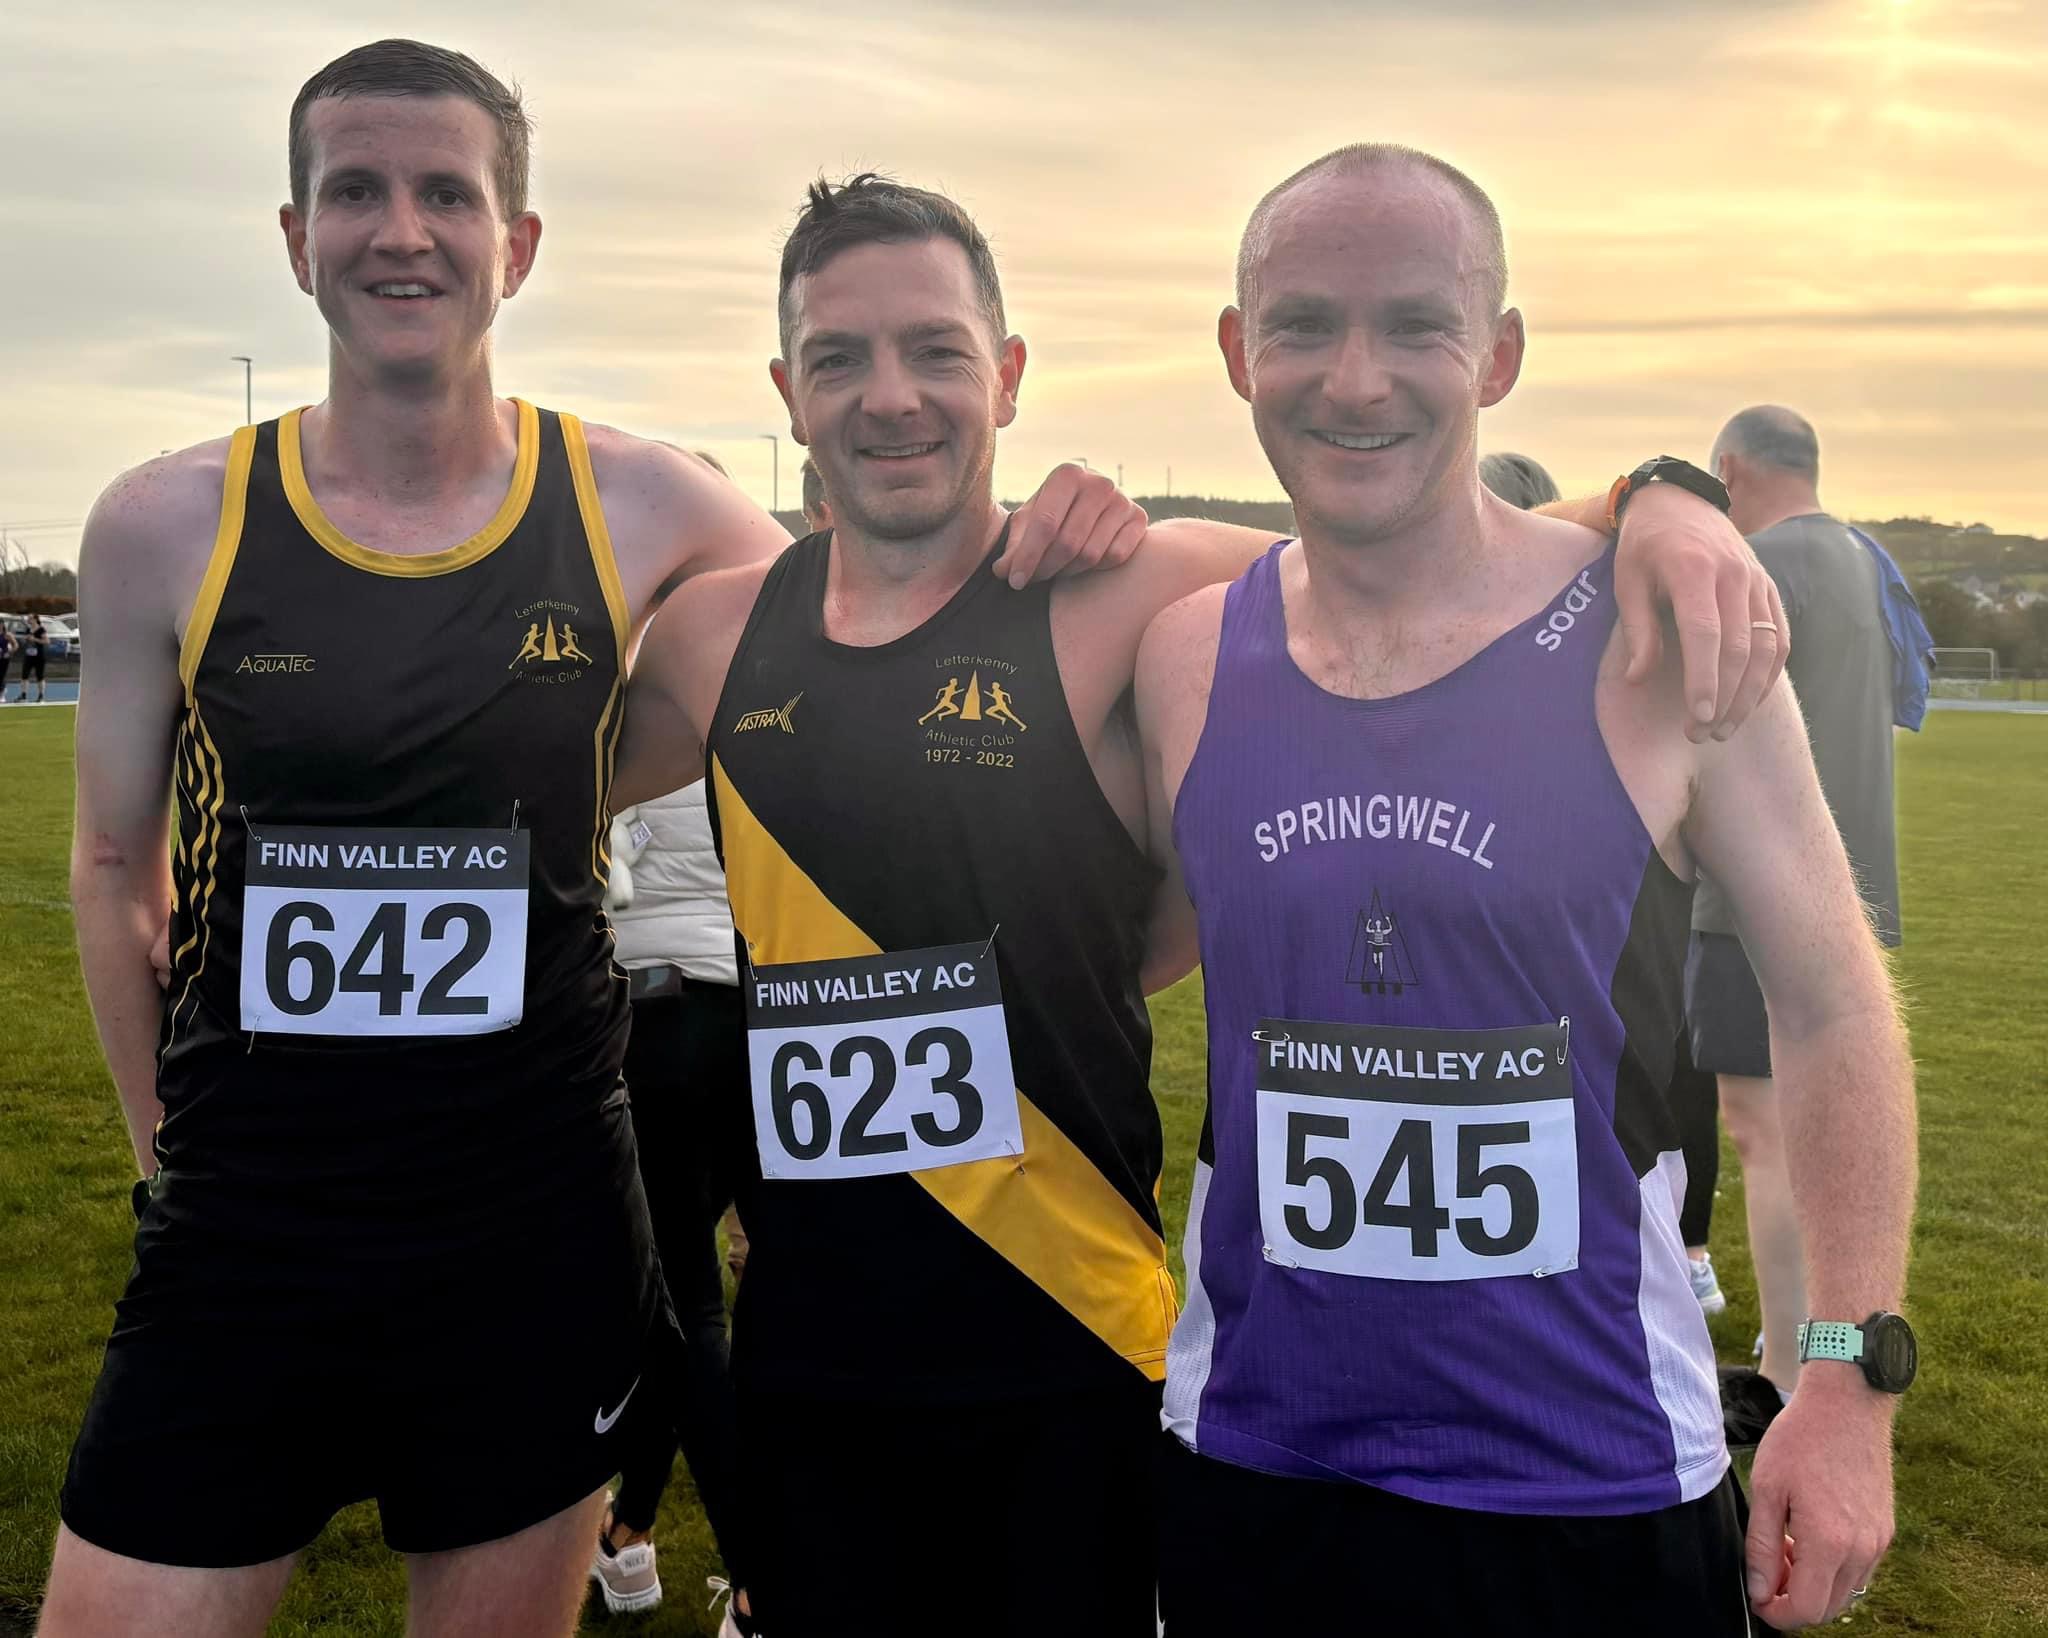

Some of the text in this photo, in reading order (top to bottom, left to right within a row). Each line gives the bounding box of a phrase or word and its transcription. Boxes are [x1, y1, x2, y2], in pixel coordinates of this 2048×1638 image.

[1535, 570, 1598, 652] soar
[515, 669, 582, 684] Aletic Club
[935, 654, 1018, 675] Letterkenny
[925, 728, 1015, 747] Athletic Club
[925, 748, 961, 762] 1972
[975, 750, 1014, 768] 2022
[1254, 794, 1496, 869] SPRINGWELL
[260, 842, 508, 870] FINN VALLEY AC
[265, 901, 492, 1016] 642
[756, 962, 976, 1008] FINN VALLEY AC
[1269, 1041, 1545, 1081] FINN VALLEY AC
[770, 1026, 984, 1161] 623
[1283, 1111, 1540, 1258] 545
